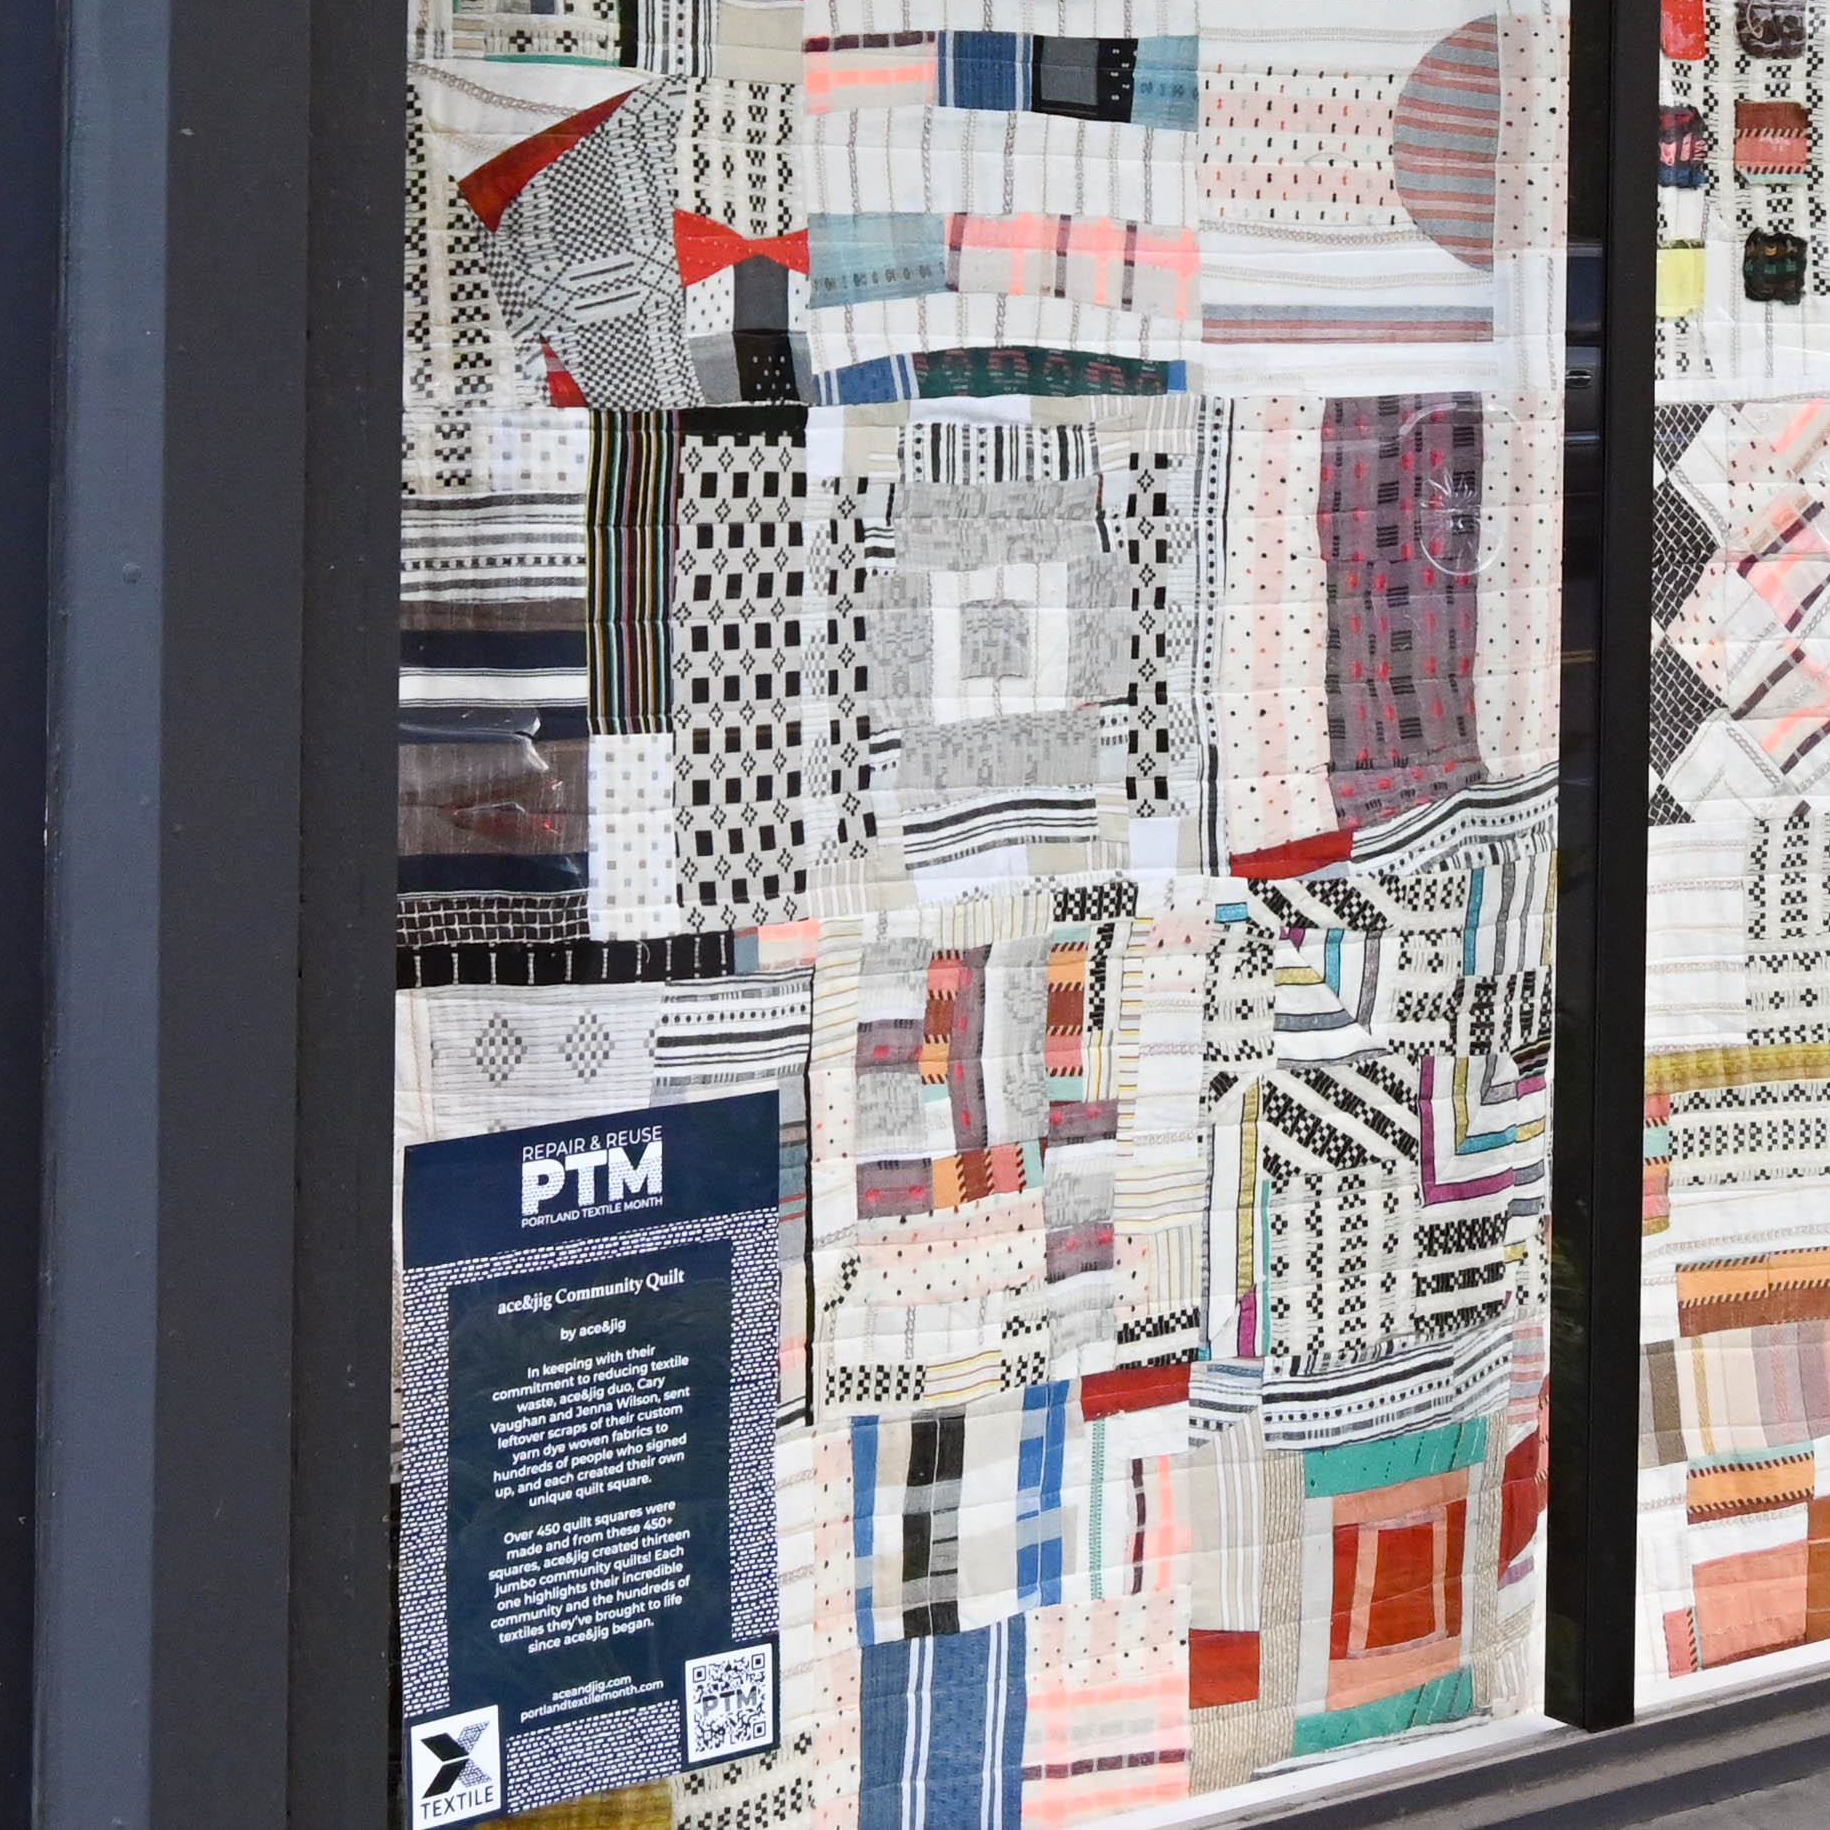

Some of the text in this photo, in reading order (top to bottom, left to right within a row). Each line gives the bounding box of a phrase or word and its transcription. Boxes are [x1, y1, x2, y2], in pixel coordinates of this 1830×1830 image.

[522, 1125, 662, 1162] REPAIR & REUSE
[522, 1141, 663, 1216] PTM
[521, 1196, 663, 1228] PORTLAND TEXTILE MONTH
[497, 1267, 684, 1314] ace&jig Community Quilt
[560, 1317, 625, 1341] by ace&jig
[492, 1354, 688, 1401] commitment to reducing textile
[527, 1344, 655, 1378] In keeping with their
[490, 1386, 690, 1434] Vaughan and Jenna Wilson, sent
[516, 1376, 665, 1412] waste, ace&jig duo, Cary
[497, 1404, 682, 1449] leftover scraps of their custom
[512, 1423, 668, 1465] yarn dye woven fabrics to
[493, 1432, 686, 1482] hundreds of people who signed
[495, 1451, 684, 1499] up, and each created their own
[528, 1474, 651, 1506] unique quilt square.
[503, 1500, 675, 1544] Over 450 quilt squares were
[506, 1516, 672, 1560] made and from these 450+
[488, 1529, 690, 1580] squares, ace&jig created thirteen
[494, 1544, 684, 1598] jumbo community quilts! Each
[490, 1574, 690, 1629] community and the hundreds of
[496, 1561, 683, 1611] one highlights their incredible
[498, 1624, 544, 1643] textiles
[595, 1601, 645, 1622] brought
[647, 1599, 661, 1610] to
[663, 1593, 682, 1607] life
[528, 1617, 653, 1653] since ace&jig began.
[520, 1679, 664, 1722] portlandtextilemonth.com
[552, 1675, 632, 1701] aceandjig.com
[702, 1685, 758, 1718] PTM
[420, 1785, 494, 1820] TEXTILE
